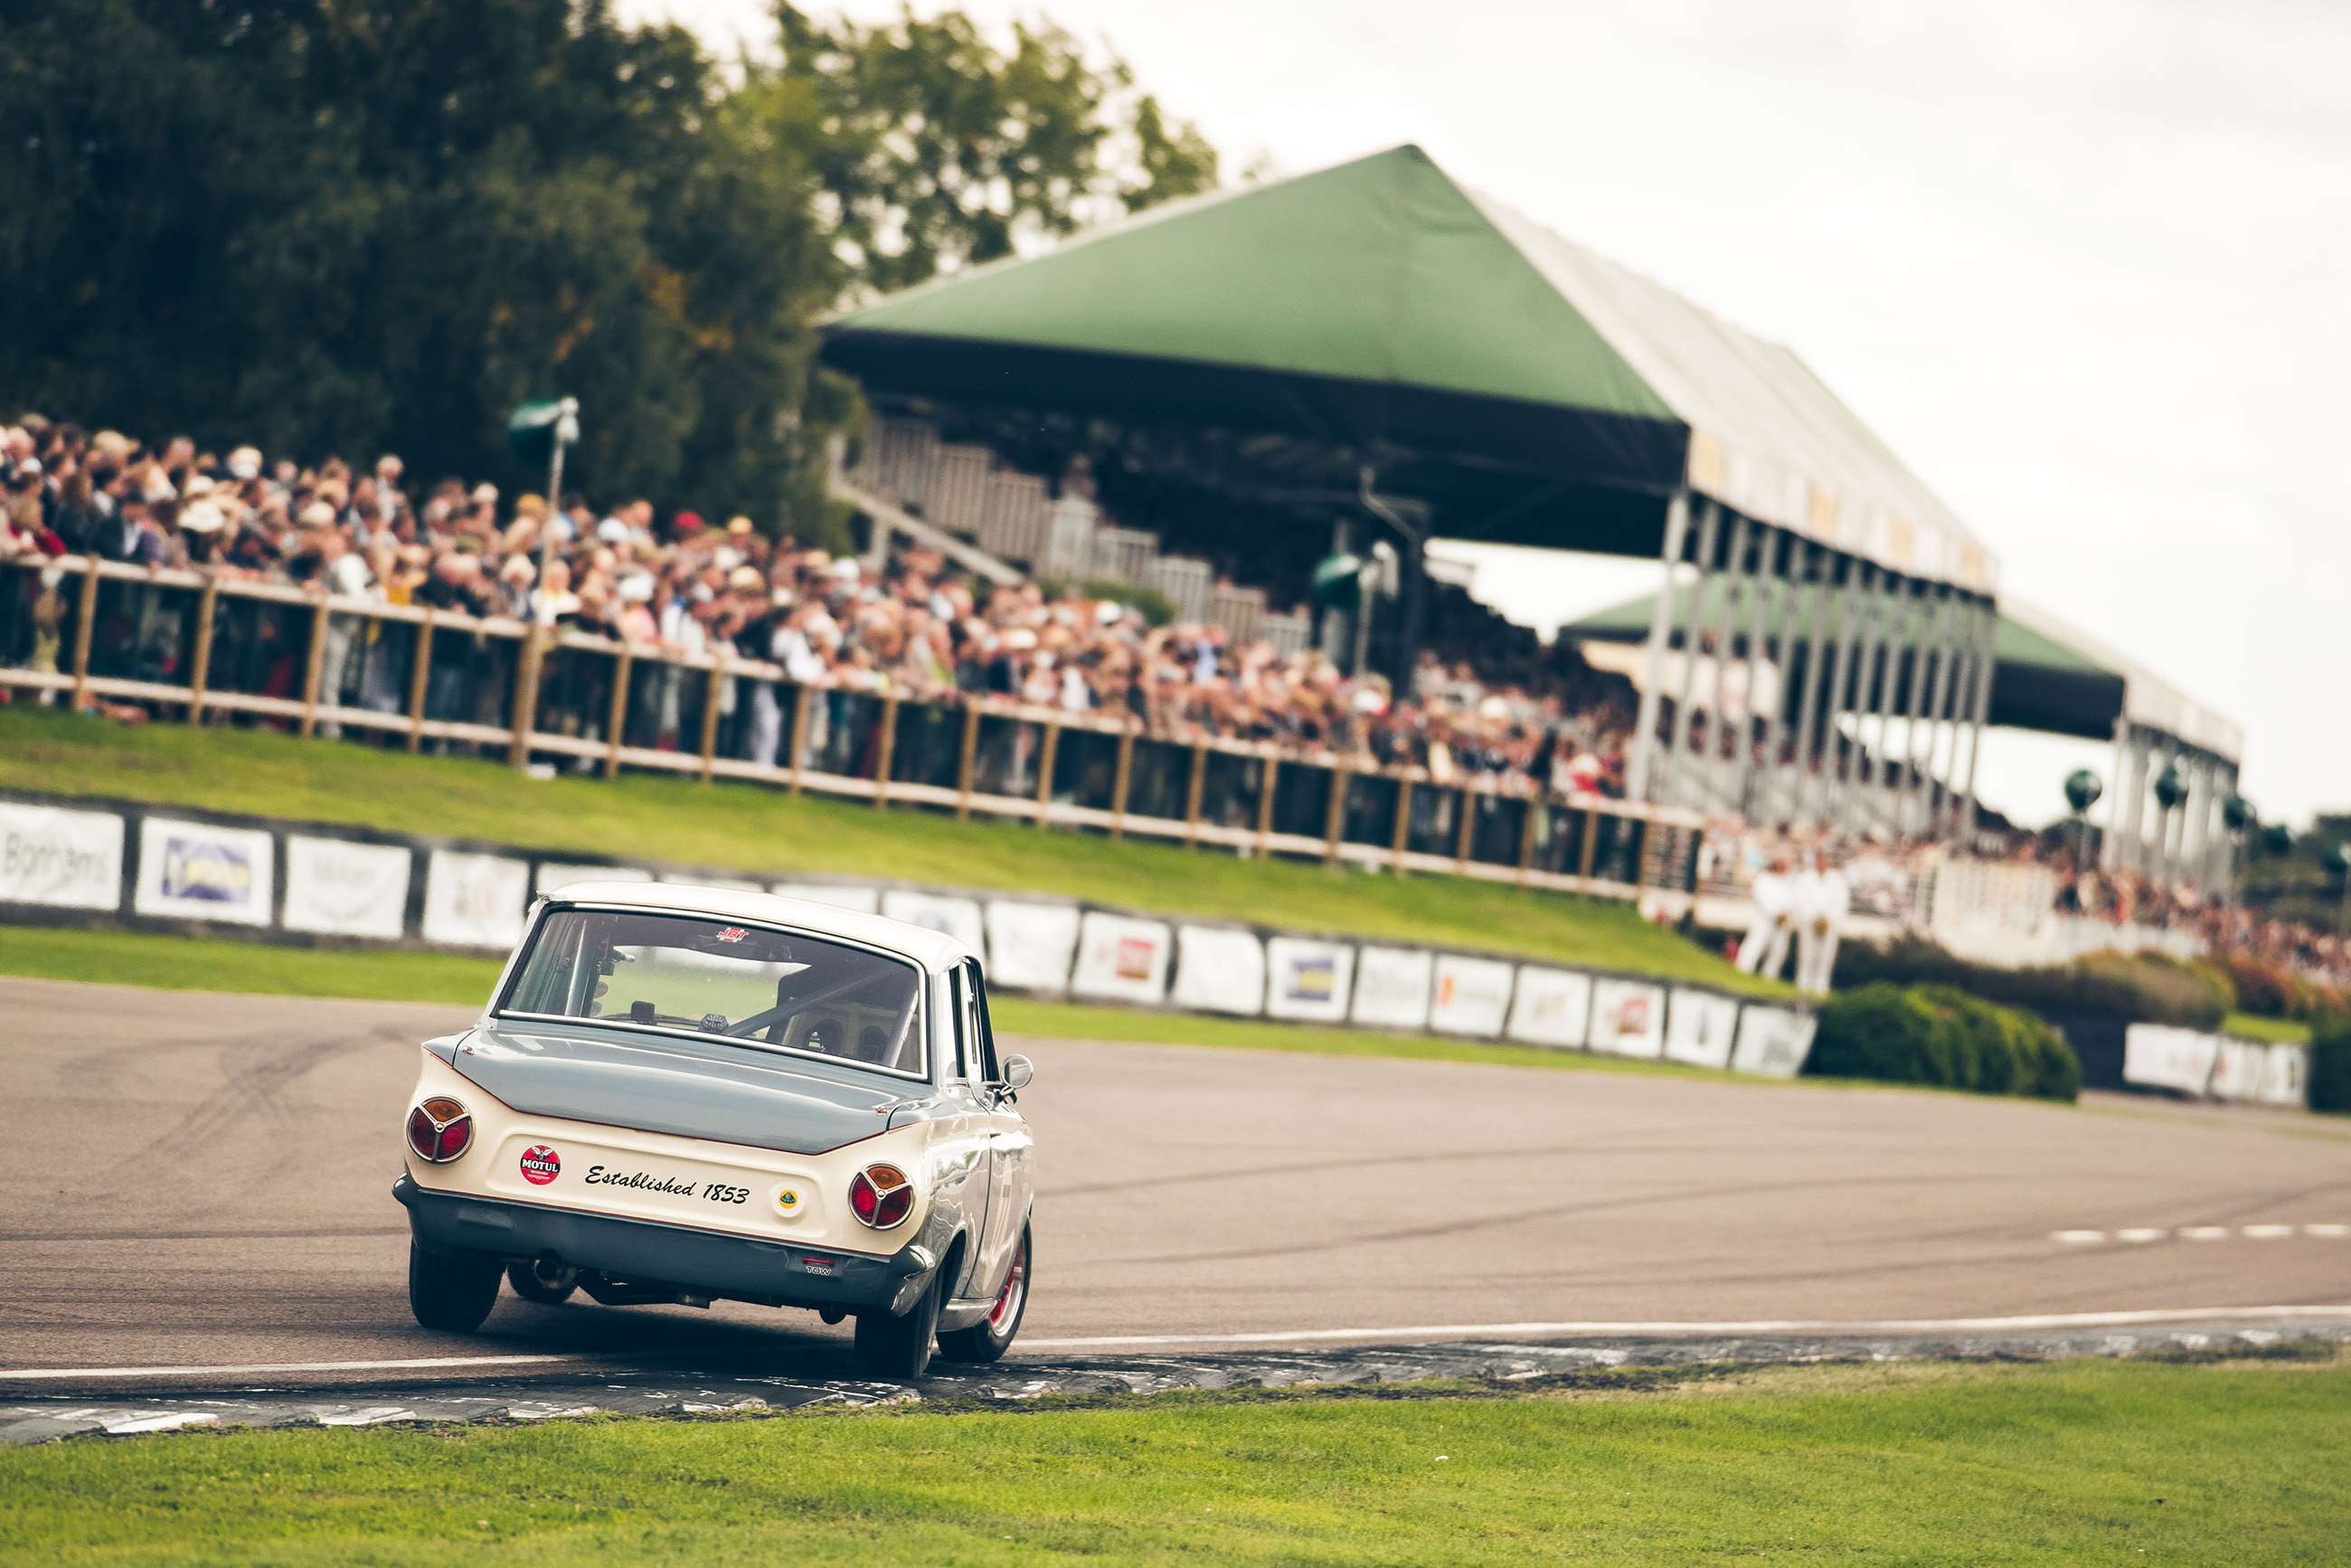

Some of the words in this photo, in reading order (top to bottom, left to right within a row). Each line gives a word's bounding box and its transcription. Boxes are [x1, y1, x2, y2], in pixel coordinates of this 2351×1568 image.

[522, 1158, 559, 1173] MOTUL
[585, 1166, 697, 1196] Established
[703, 1184, 750, 1204] 1853
[805, 1265, 833, 1276] TOW
